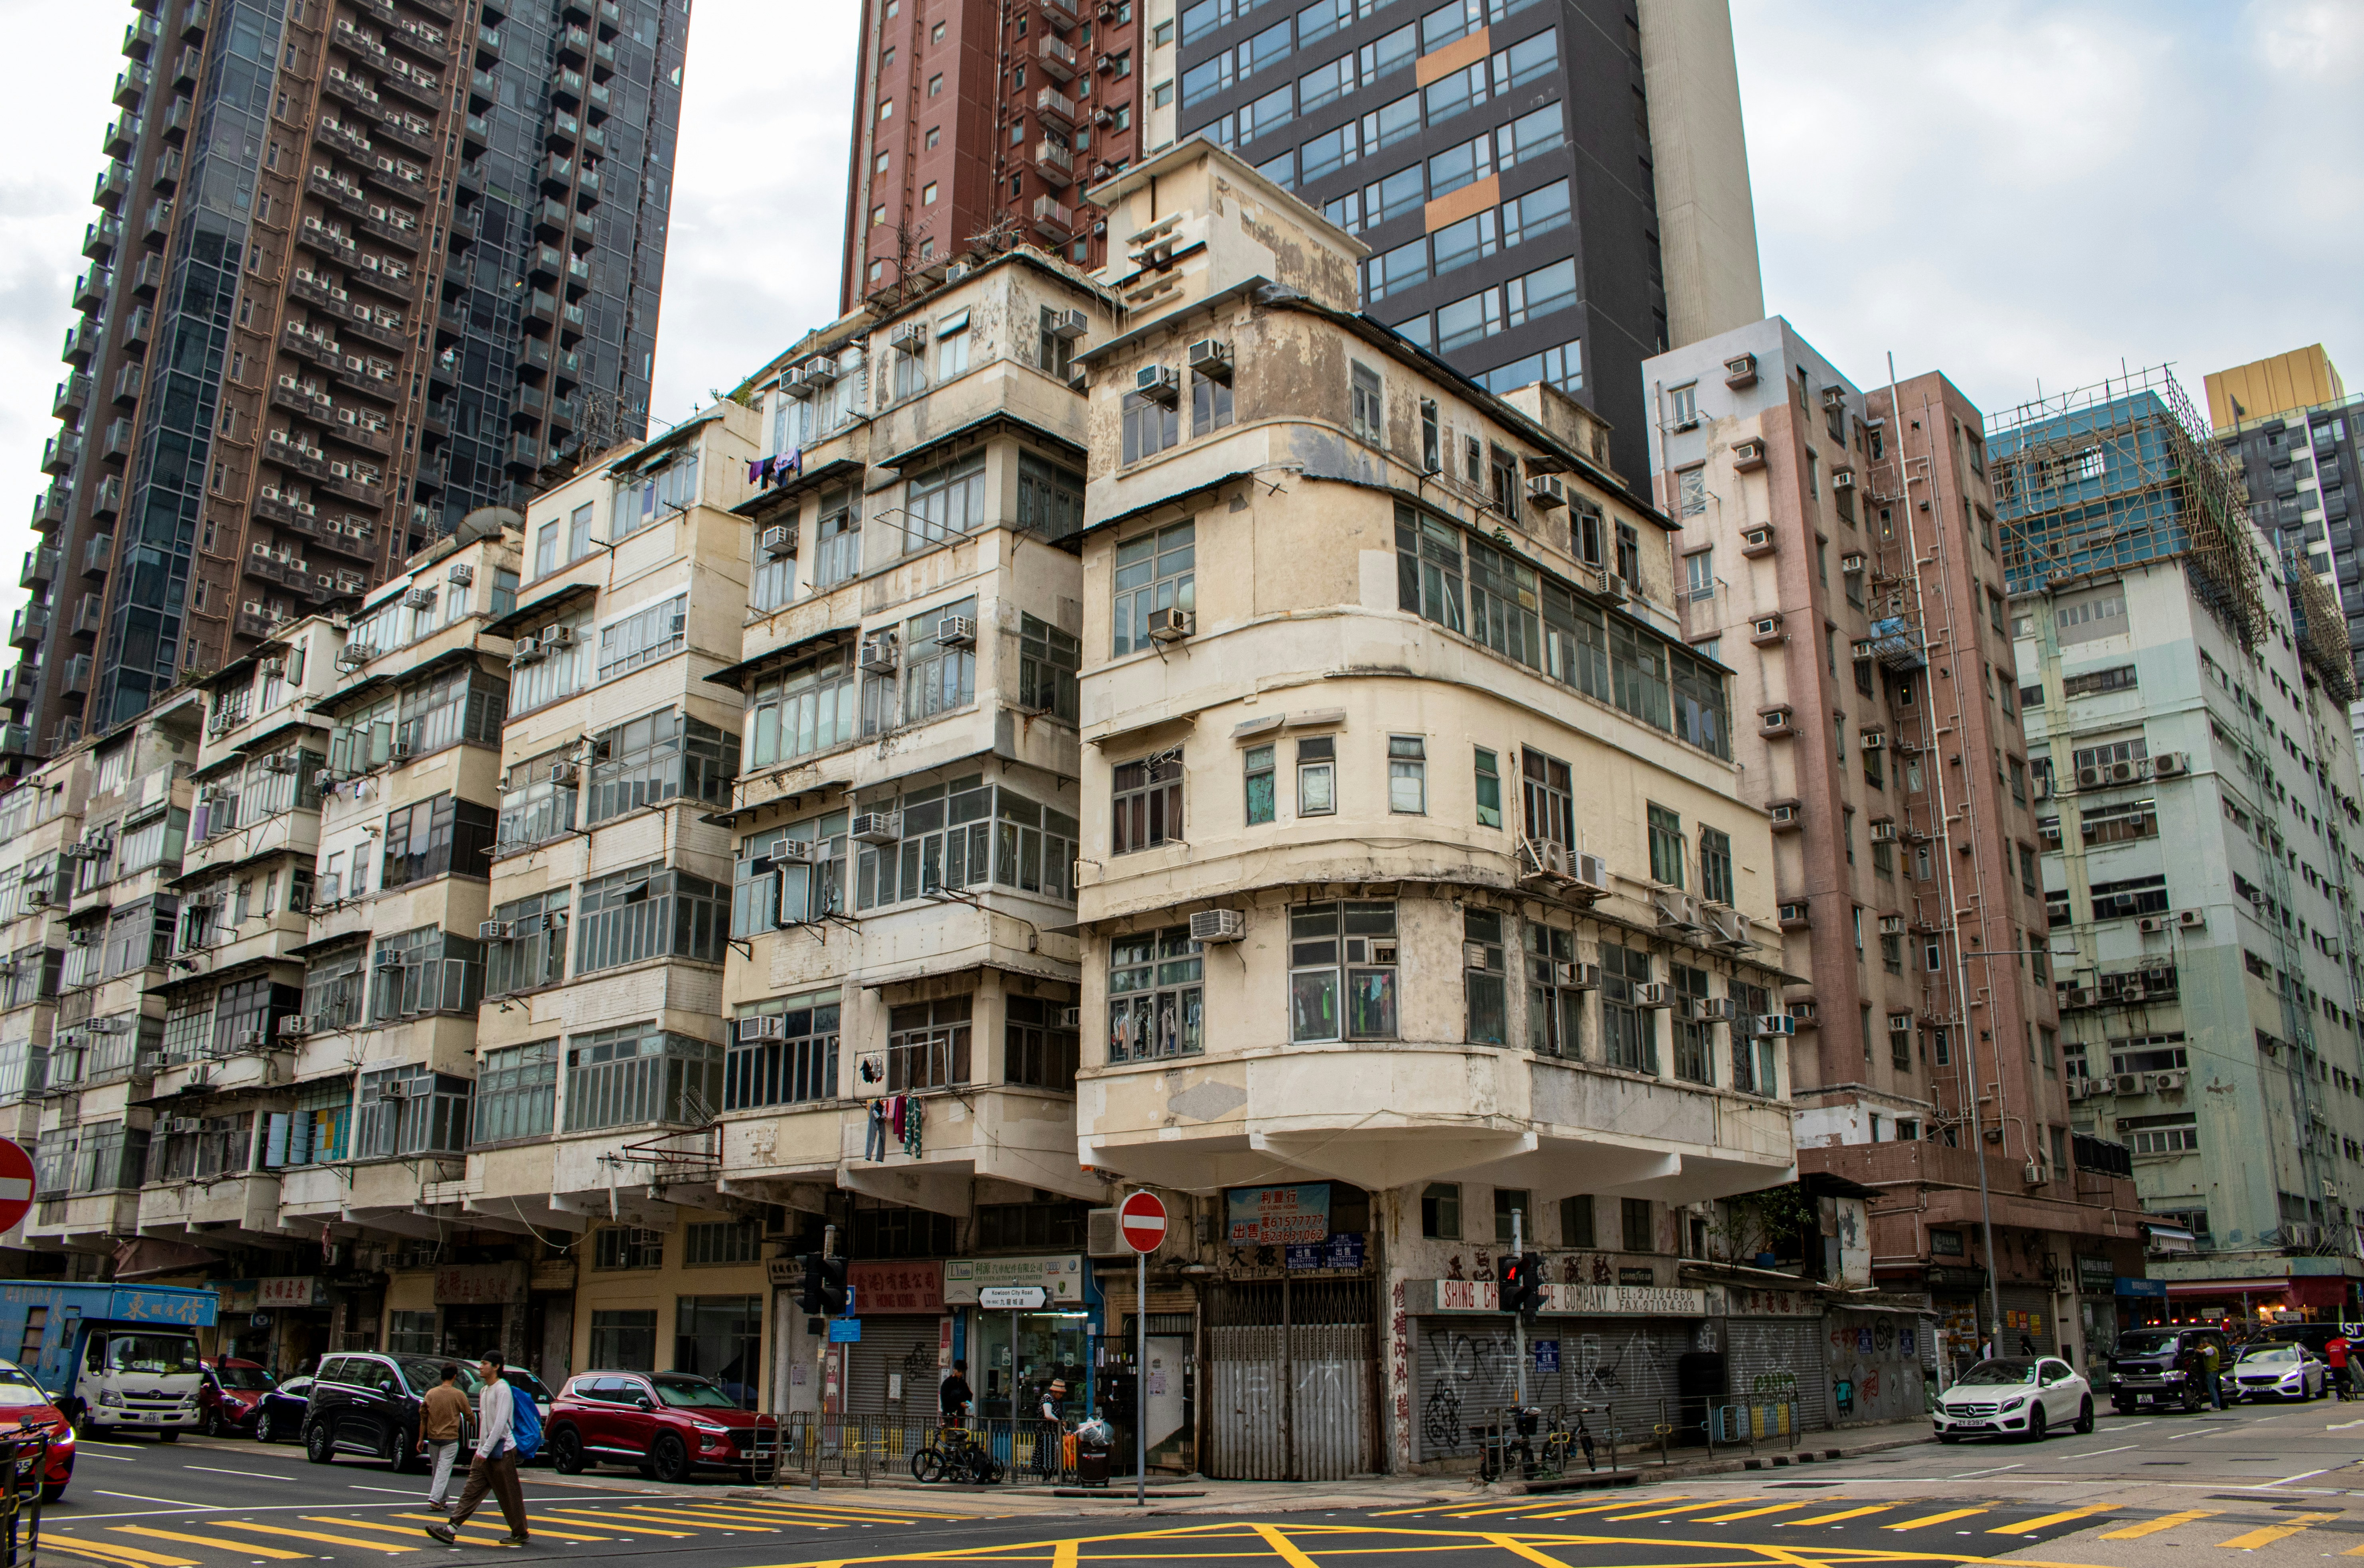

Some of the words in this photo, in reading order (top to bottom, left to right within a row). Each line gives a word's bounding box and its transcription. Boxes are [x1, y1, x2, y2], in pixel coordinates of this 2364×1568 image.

[1261, 1190, 1297, 1204] 利豐行
[1271, 1215, 1324, 1227] 61577777
[1233, 1223, 1259, 1239] 出售
[1270, 1229, 1324, 1242] 23631062
[1620, 1271, 1652, 1281] GOODYEAR
[1445, 1282, 1474, 1308] SHING
[1564, 1285, 1608, 1312] COMPANY
